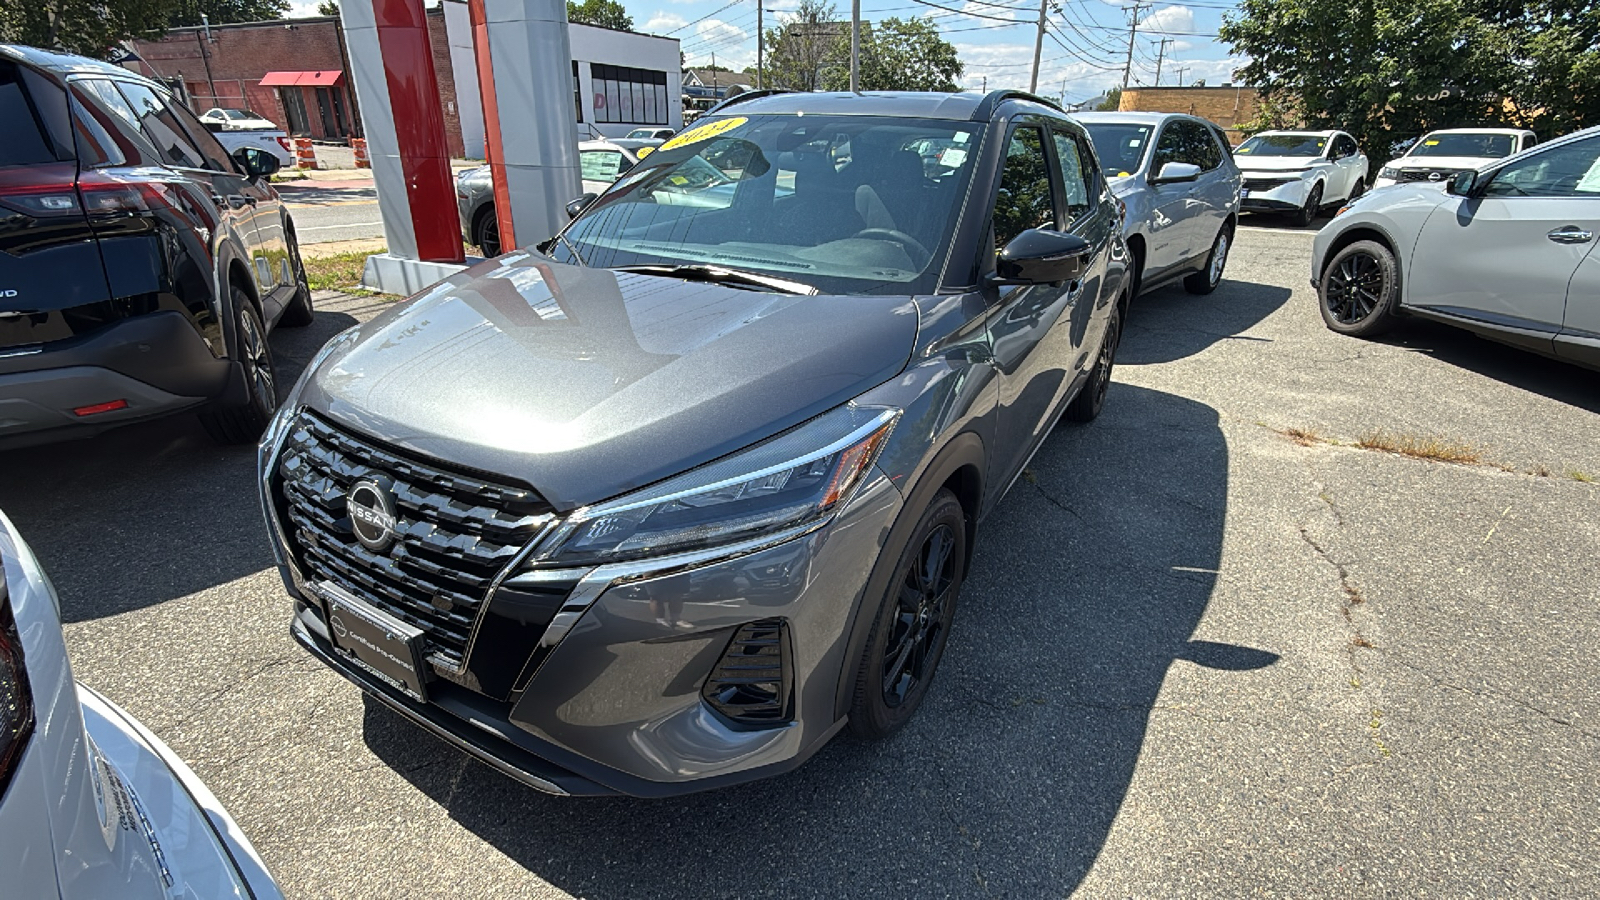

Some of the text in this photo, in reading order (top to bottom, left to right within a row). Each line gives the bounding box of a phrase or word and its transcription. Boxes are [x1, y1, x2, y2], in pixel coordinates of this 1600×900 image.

[594, 92, 664, 112] DUCATI
[347, 501, 394, 528] NISSAN
[349, 631, 414, 672] Certified Pre-Owned
